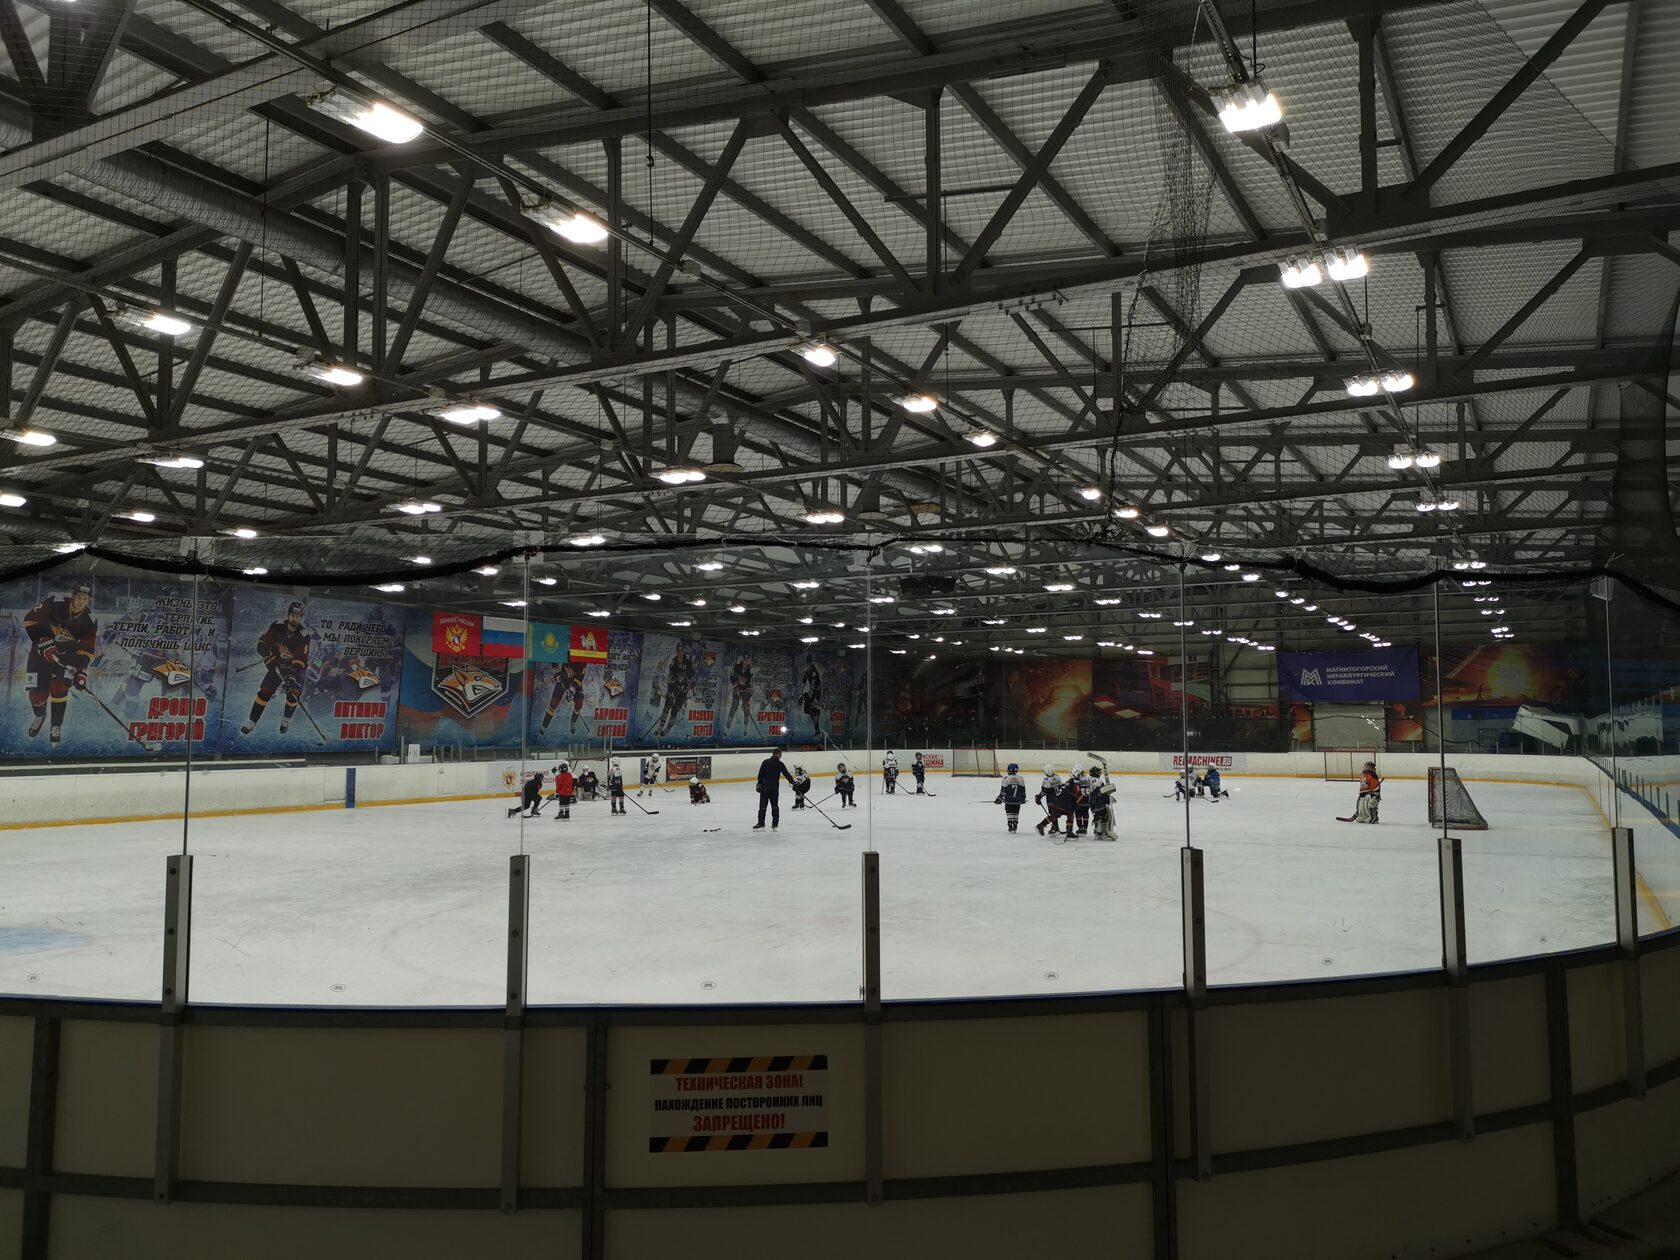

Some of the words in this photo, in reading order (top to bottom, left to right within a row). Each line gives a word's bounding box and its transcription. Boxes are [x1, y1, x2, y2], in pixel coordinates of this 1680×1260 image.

[322, 632, 341, 643] МЫ
[119, 638, 180, 651] ПОЛУЧИШЬ
[1326, 664, 1388, 673] МАГНИТОГОРСКИЙ
[1327, 671, 1395, 679] МЕТАЛЛУРГИЧЕСКИЙ
[1328, 678, 1364, 686] КОМБИНАТ
[340, 721, 386, 740] ВИКТОР
[676, 1075, 763, 1092] ТЕХНИЧЕСКАЯ
[765, 1074, 804, 1089] ЗОНА!
[655, 1097, 724, 1112] НАХОЖДЕНИЕ
[725, 1096, 800, 1110] ПОСТОРОННИХ
[801, 1094, 823, 1108] ЛИЦ
[693, 1113, 786, 1133] ЗАПРЕЩЕНО!
